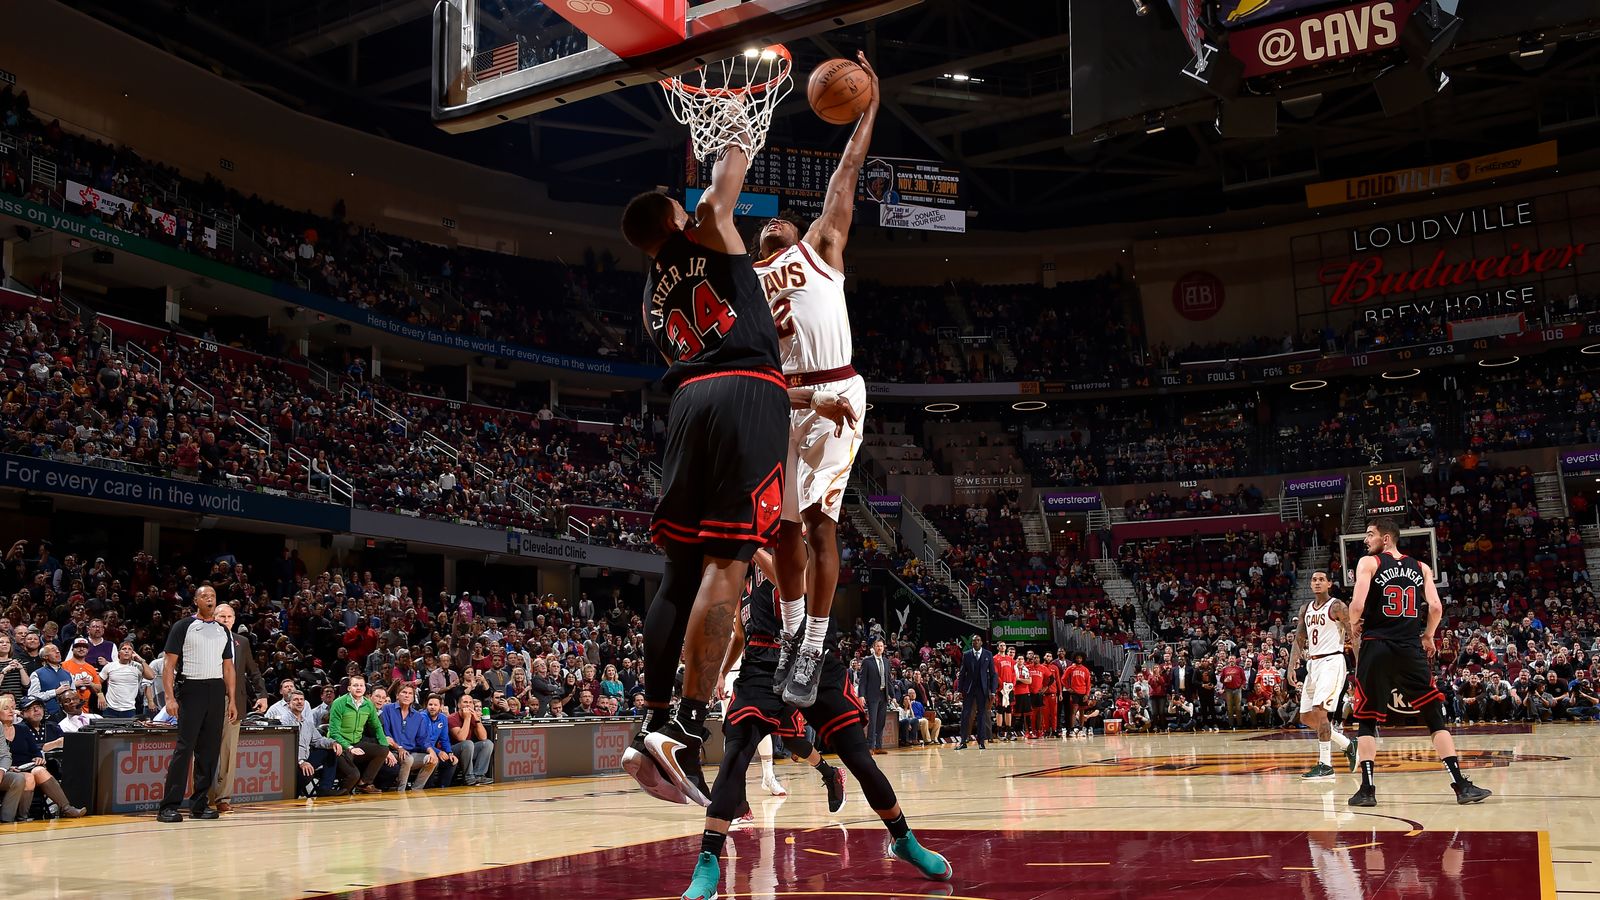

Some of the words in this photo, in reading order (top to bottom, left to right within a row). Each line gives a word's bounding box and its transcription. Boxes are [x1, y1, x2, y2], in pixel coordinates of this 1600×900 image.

[1258, 2, 1396, 66] @CAVS
[898, 178, 913, 190] NOV.
[932, 181, 957, 194] 7:30PM
[1346, 168, 1452, 200] LOUDVILLE
[911, 218, 929, 227] YOUR
[930, 215, 946, 223] RIDE!
[915, 210, 939, 220] DONATE
[28, 209, 47, 222] on
[52, 216, 86, 233] your
[90, 227, 123, 247] care.
[1353, 202, 1532, 250] LOUDVILLE
[764, 262, 806, 300] AVS
[1318, 242, 1585, 306] Budweiser
[651, 265, 682, 330] CARTER
[665, 279, 737, 361] 34
[205, 343, 218, 352] 109
[368, 314, 387, 328] Here
[389, 320, 400, 332] for
[402, 327, 426, 340] every
[428, 330, 442, 342] fan
[445, 334, 453, 344] in
[455, 337, 469, 348] the
[472, 341, 497, 353] world.
[500, 345, 515, 356] For
[517, 350, 539, 363] every
[542, 354, 560, 365] care
[562, 358, 569, 367] in
[571, 359, 585, 370] the
[587, 362, 612, 373] world.
[1351, 355, 1368, 367] 110
[1428, 344, 1454, 356] 29.3
[1541, 329, 1564, 341] 106
[1162, 375, 1180, 385] TOL:
[1186, 374, 1193, 385] 2
[1207, 372, 1235, 382] FOULS
[1263, 367, 1283, 377] FG%
[1288, 364, 1302, 375] 52
[1566, 453, 1600, 464] everst
[6, 460, 40, 483] For
[46, 471, 98, 496] every
[103, 480, 142, 498] care
[148, 482, 162, 500] in
[168, 486, 194, 504] the
[198, 493, 245, 512] world.
[1290, 479, 1341, 490] everstream
[1368, 474, 1392, 486] 29.1
[1048, 496, 1096, 505] everstream
[1380, 485, 1398, 503] 10
[523, 540, 563, 556] Cleveland
[565, 545, 587, 559] Clinic
[1375, 567, 1424, 587] SATORANSKY
[1382, 585, 1418, 618] 31
[1306, 613, 1325, 627] CAVS
[1004, 625, 1047, 637] Huntington
[1312, 629, 1318, 645] 8
[505, 730, 539, 758] drug
[596, 728, 624, 752] drug
[236, 751, 272, 774] rug
[508, 756, 546, 775] mart
